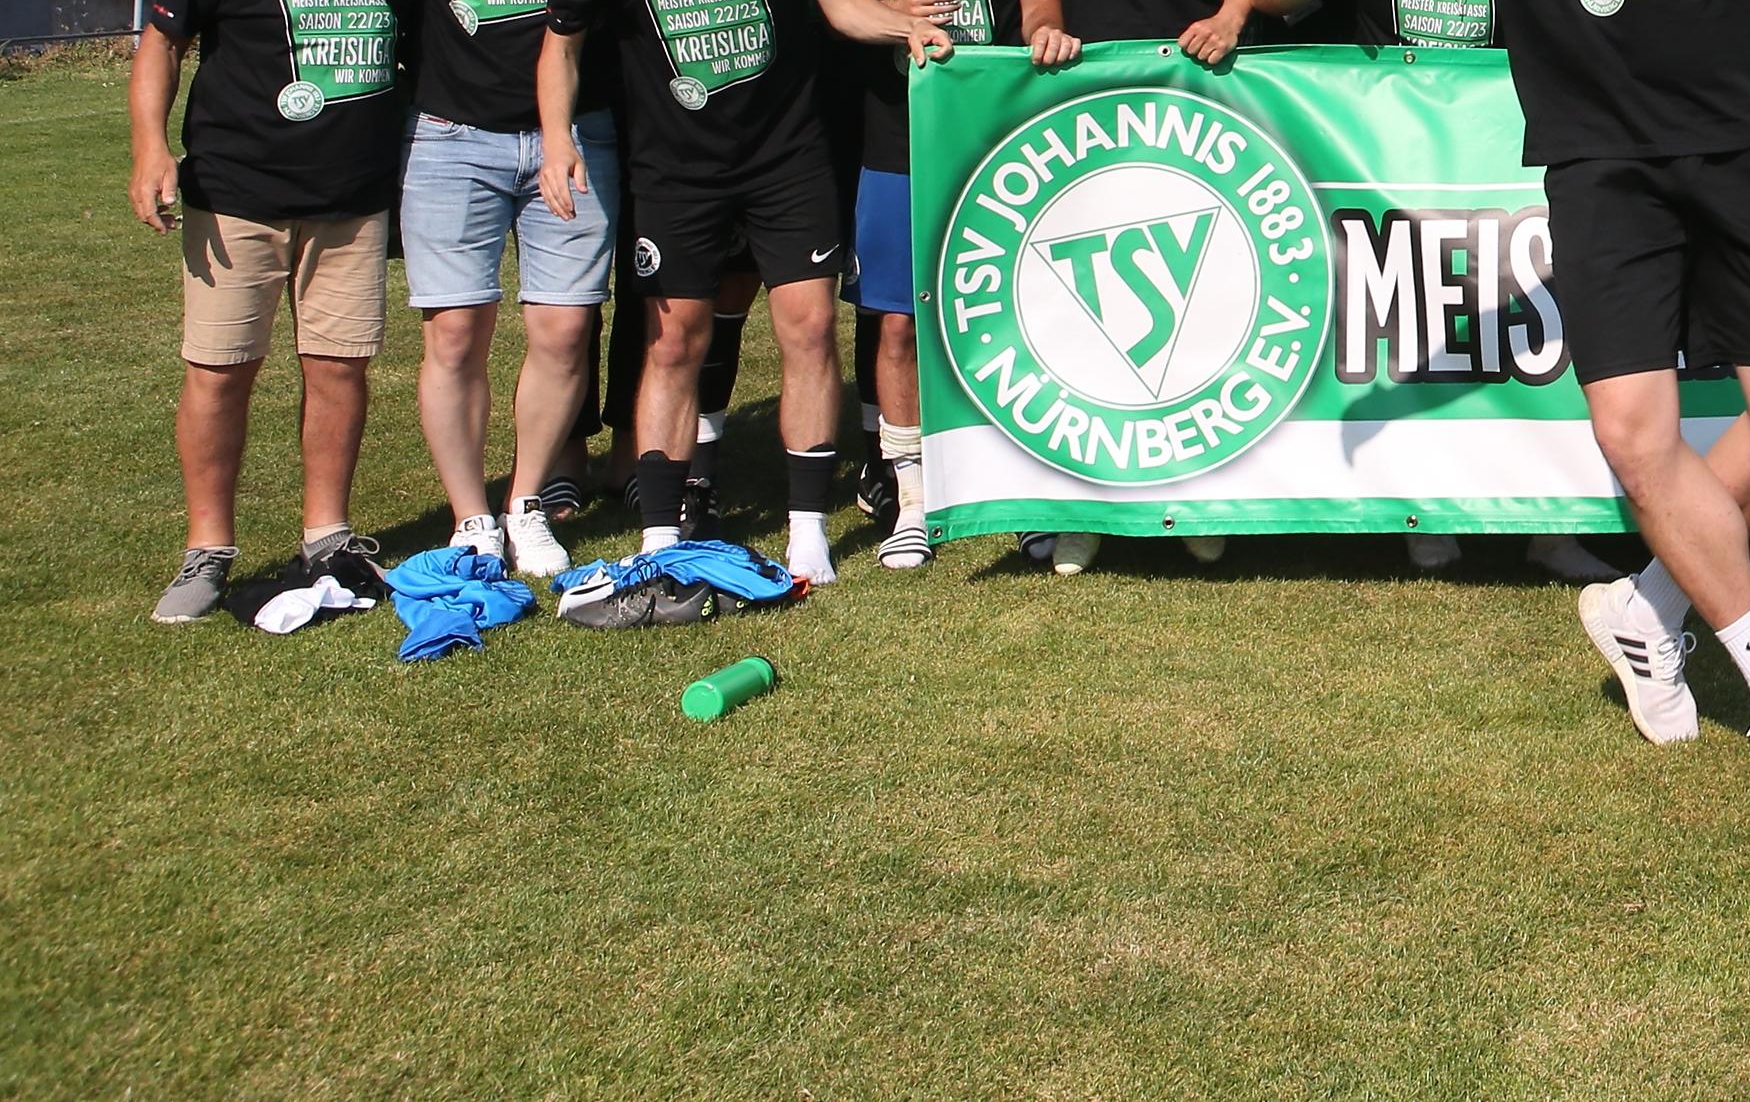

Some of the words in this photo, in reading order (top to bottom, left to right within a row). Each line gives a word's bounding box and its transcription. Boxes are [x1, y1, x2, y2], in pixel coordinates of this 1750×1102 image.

[298, 13, 341, 30] SAISON
[347, 12, 391, 29] 22/23
[666, 10, 710, 31] SAISON
[714, 1, 760, 24] 22/23
[1404, 14, 1443, 34] SAISON
[1446, 20, 1487, 37] 22/23
[301, 37, 390, 66] KREISLIGA
[675, 23, 770, 63] KREISLIGA
[335, 69, 355, 83] WIR
[359, 68, 391, 83] KOMMEN
[711, 58, 731, 74] WIR
[975, 101, 1247, 233] JOHANNIS
[1237, 162, 1314, 267] 1883
[954, 227, 1006, 333] TSV
[1049, 214, 1213, 369] TSV
[1335, 211, 1570, 381] MEIS
[974, 346, 1272, 470] NÜRNBERG
